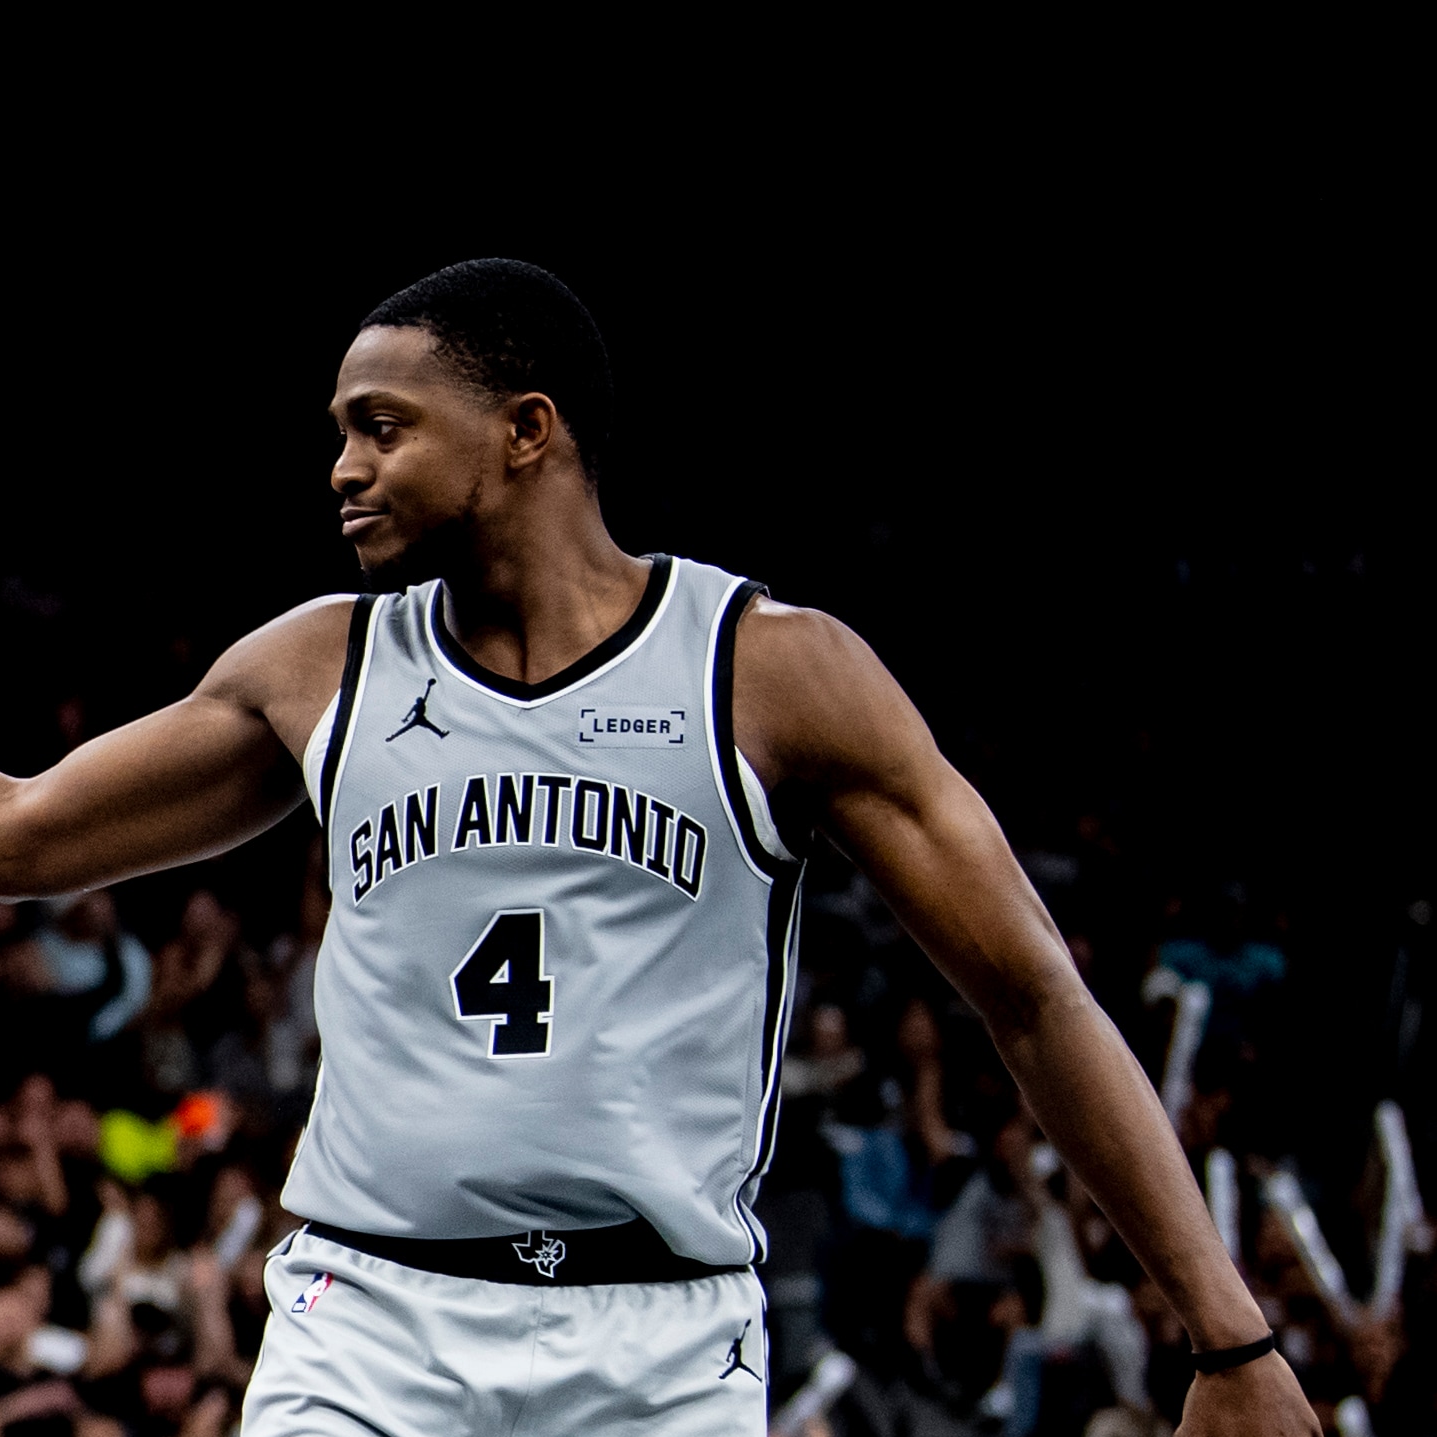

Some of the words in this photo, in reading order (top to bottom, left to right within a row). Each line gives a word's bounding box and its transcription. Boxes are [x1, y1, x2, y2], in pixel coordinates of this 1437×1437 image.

[592, 717, 672, 735] LEDGER
[350, 782, 441, 907] SAN
[450, 772, 708, 902] ANTONIO
[448, 908, 556, 1060] 4
